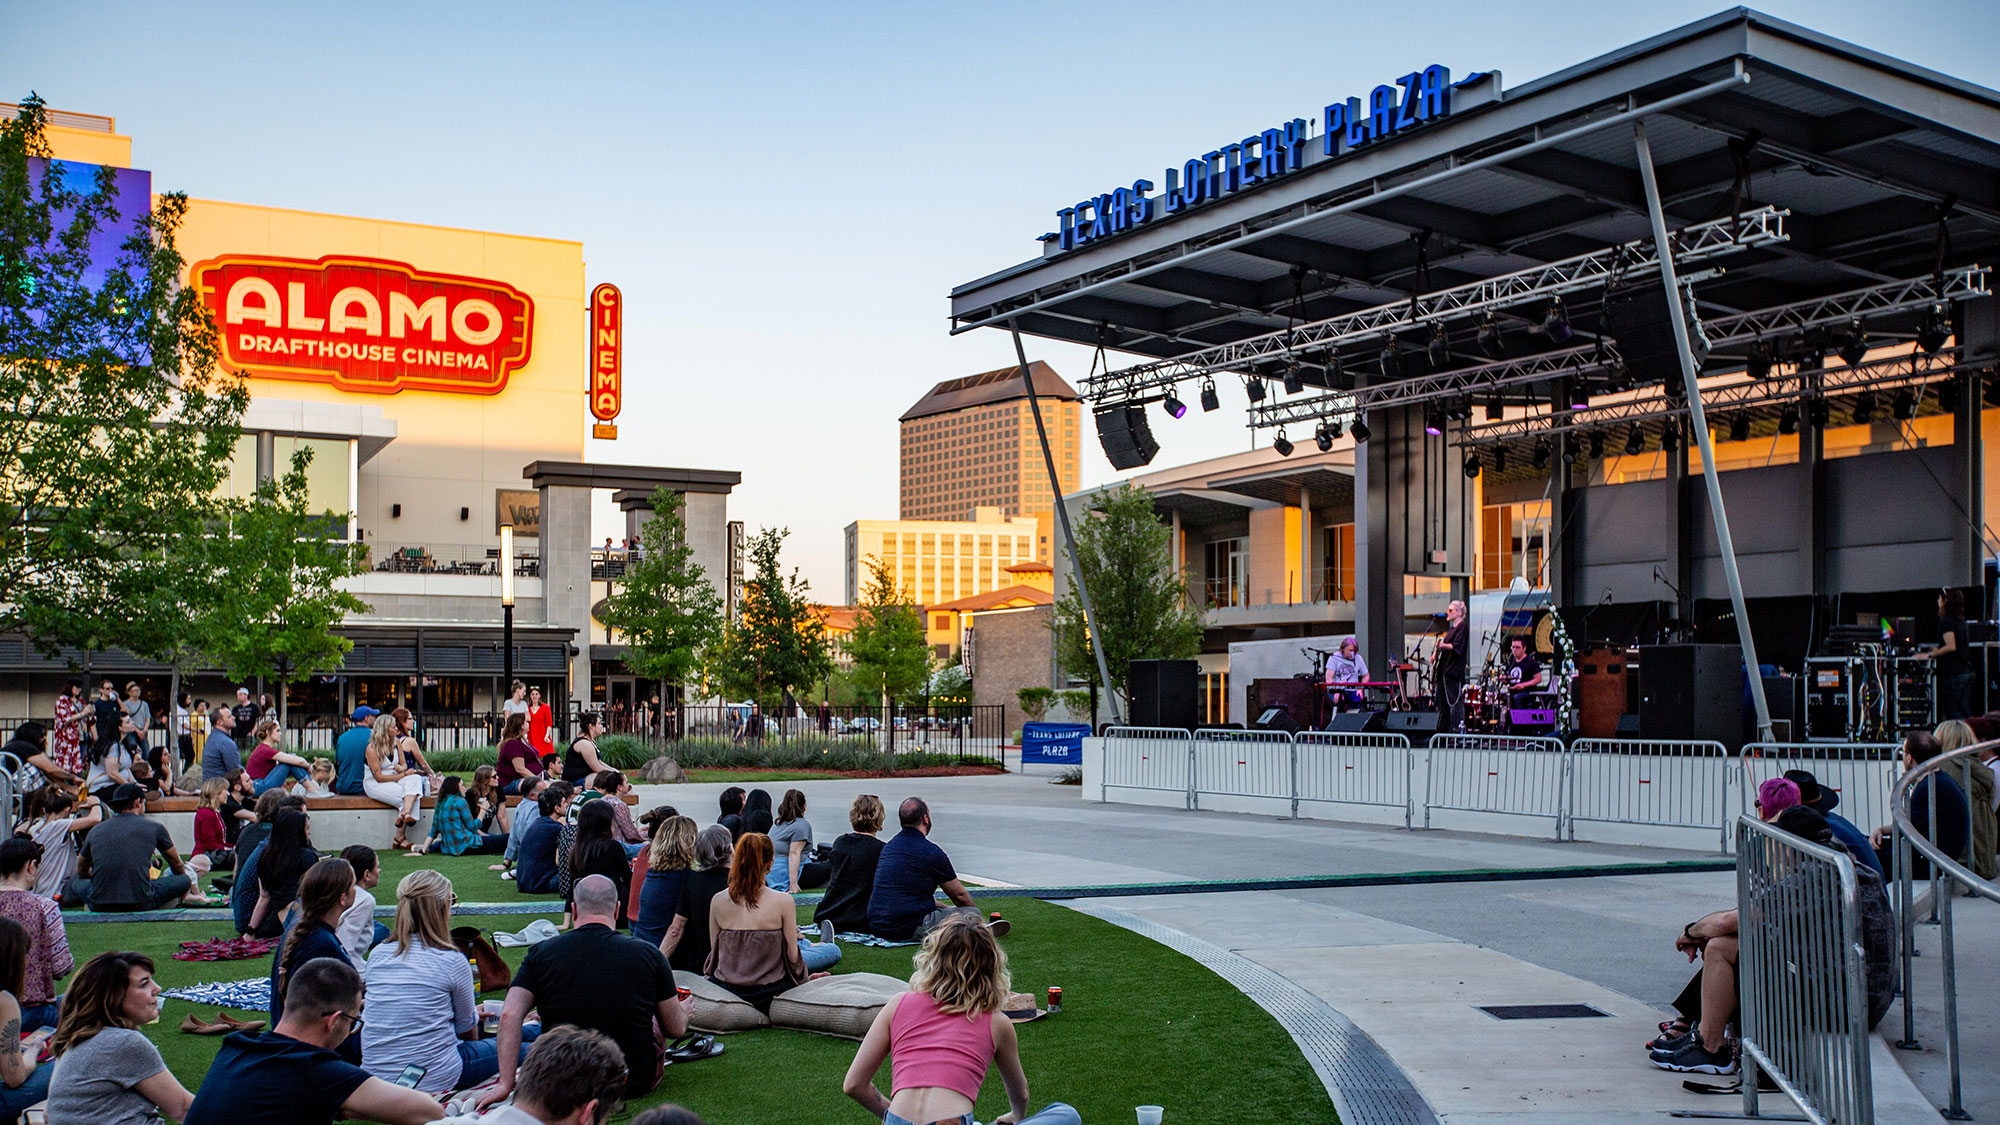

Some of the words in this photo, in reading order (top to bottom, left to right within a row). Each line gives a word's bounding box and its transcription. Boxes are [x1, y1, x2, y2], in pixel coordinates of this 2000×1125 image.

[1056, 179, 1153, 250] TEXAS
[1165, 118, 1306, 214] LOTTERY
[1324, 64, 1450, 156] PLAZA
[225, 276, 503, 346] ALAMO
[239, 333, 396, 363] DRAFTHOUSE
[402, 347, 489, 370] CINEMA
[597, 289, 616, 411] CINEMA
[734, 524, 743, 570] YARD
[1032, 731, 1053, 739] TEXAS
[1042, 745, 1068, 756] PLAZA
